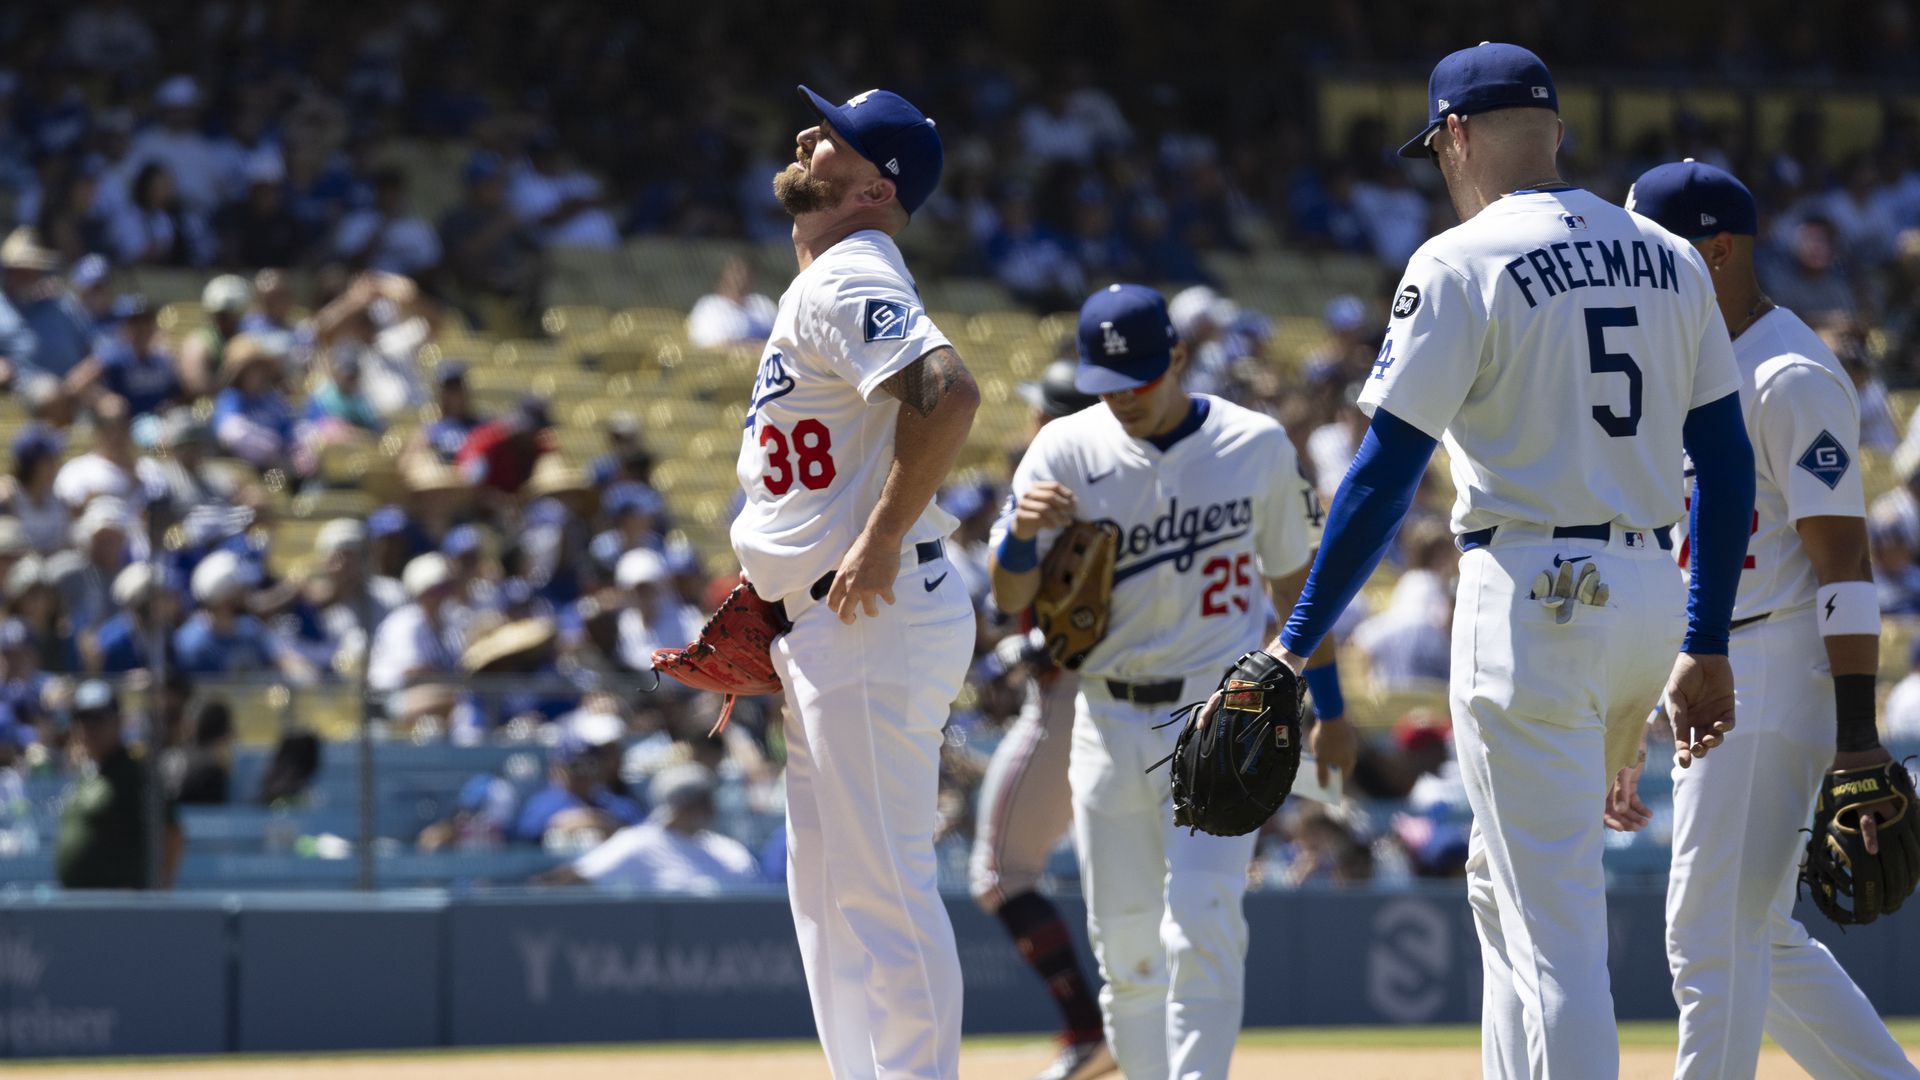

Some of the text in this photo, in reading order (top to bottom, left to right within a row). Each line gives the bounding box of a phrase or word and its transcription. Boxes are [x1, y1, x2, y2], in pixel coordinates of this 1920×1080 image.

[1395, 296, 1414, 315] 34
[1505, 239, 1680, 309] FREEMAN
[1100, 321, 1129, 355] LA
[1368, 327, 1396, 379] A
[1584, 306, 1643, 438] 5
[760, 418, 837, 495] 38
[1202, 553, 1252, 617] 25
